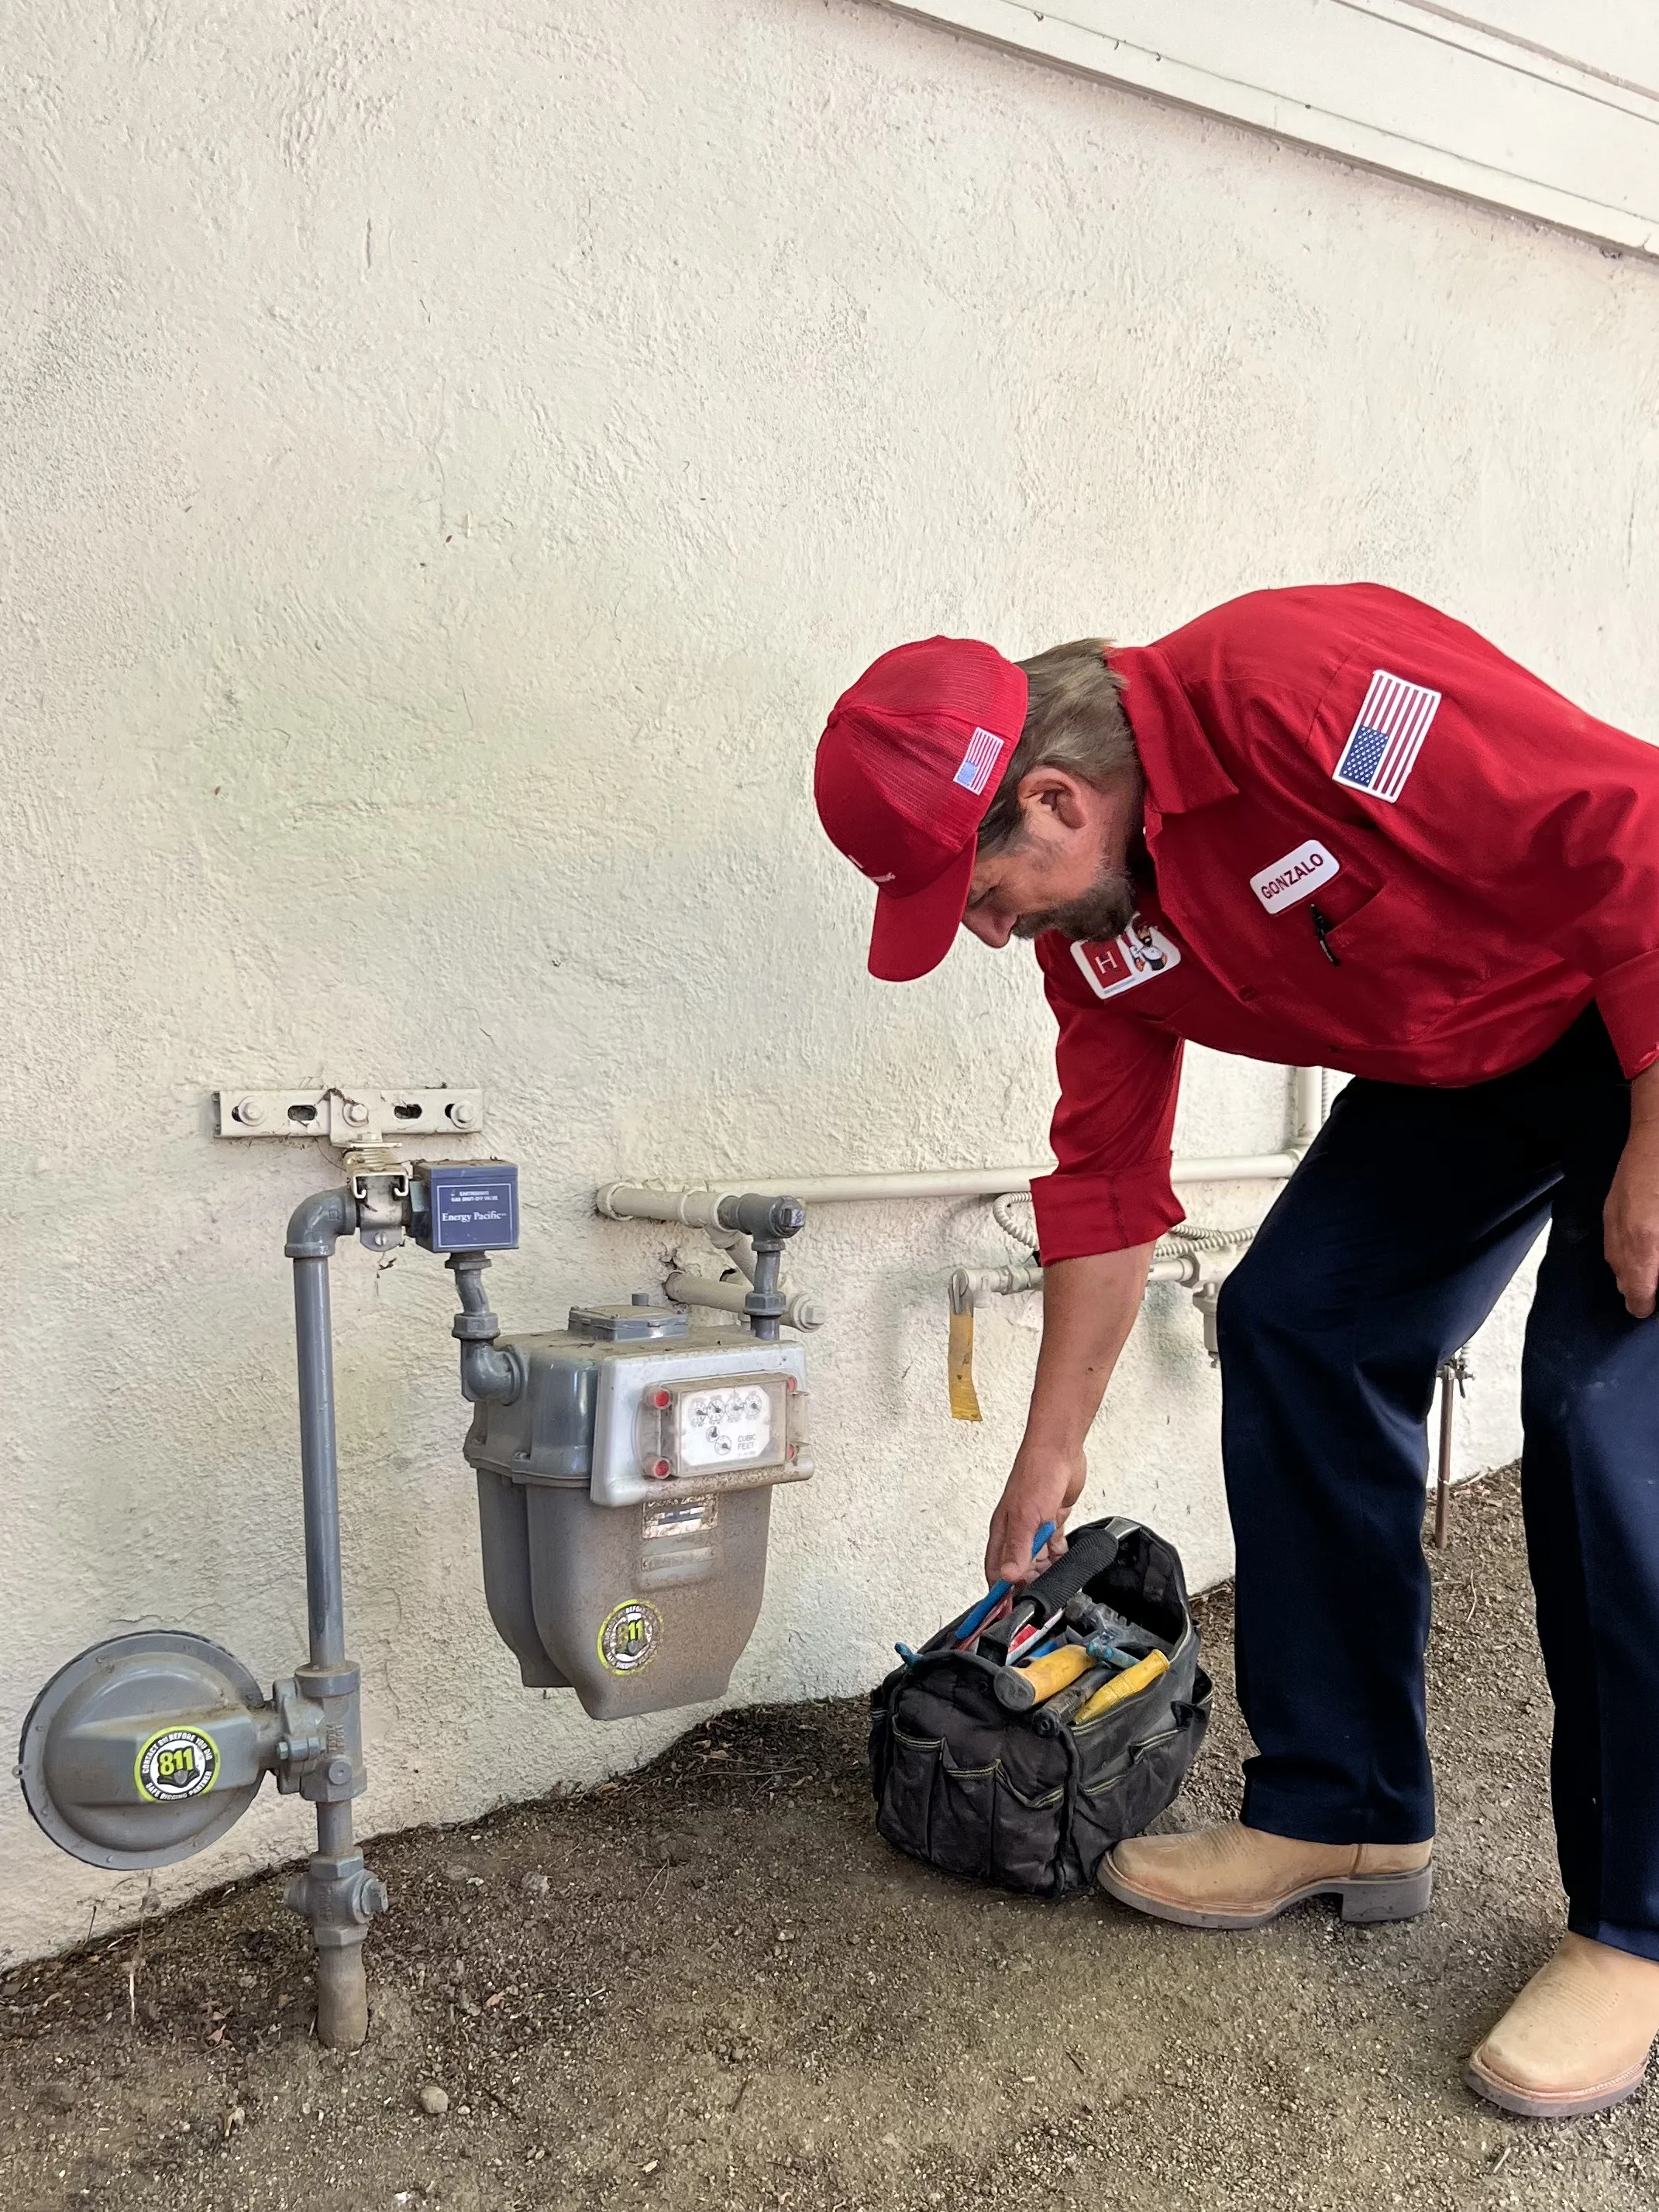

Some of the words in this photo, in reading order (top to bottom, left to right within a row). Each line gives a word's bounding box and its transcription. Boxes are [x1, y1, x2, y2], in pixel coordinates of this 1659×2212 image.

[1261, 853, 1323, 899] GONZALO
[1094, 951, 1118, 974] H
[442, 1213, 472, 1223] Energy
[473, 1210, 501, 1220] Pacific
[738, 1442, 754, 1450] FEET
[142, 1743, 159, 1774] CONTACT
[168, 1732, 196, 1742] BEFORE
[195, 1737, 208, 1750] YOU
[204, 1748, 213, 1761] DIG
[159, 1747, 194, 1776] 811
[145, 1782, 161, 1797] SAFE
